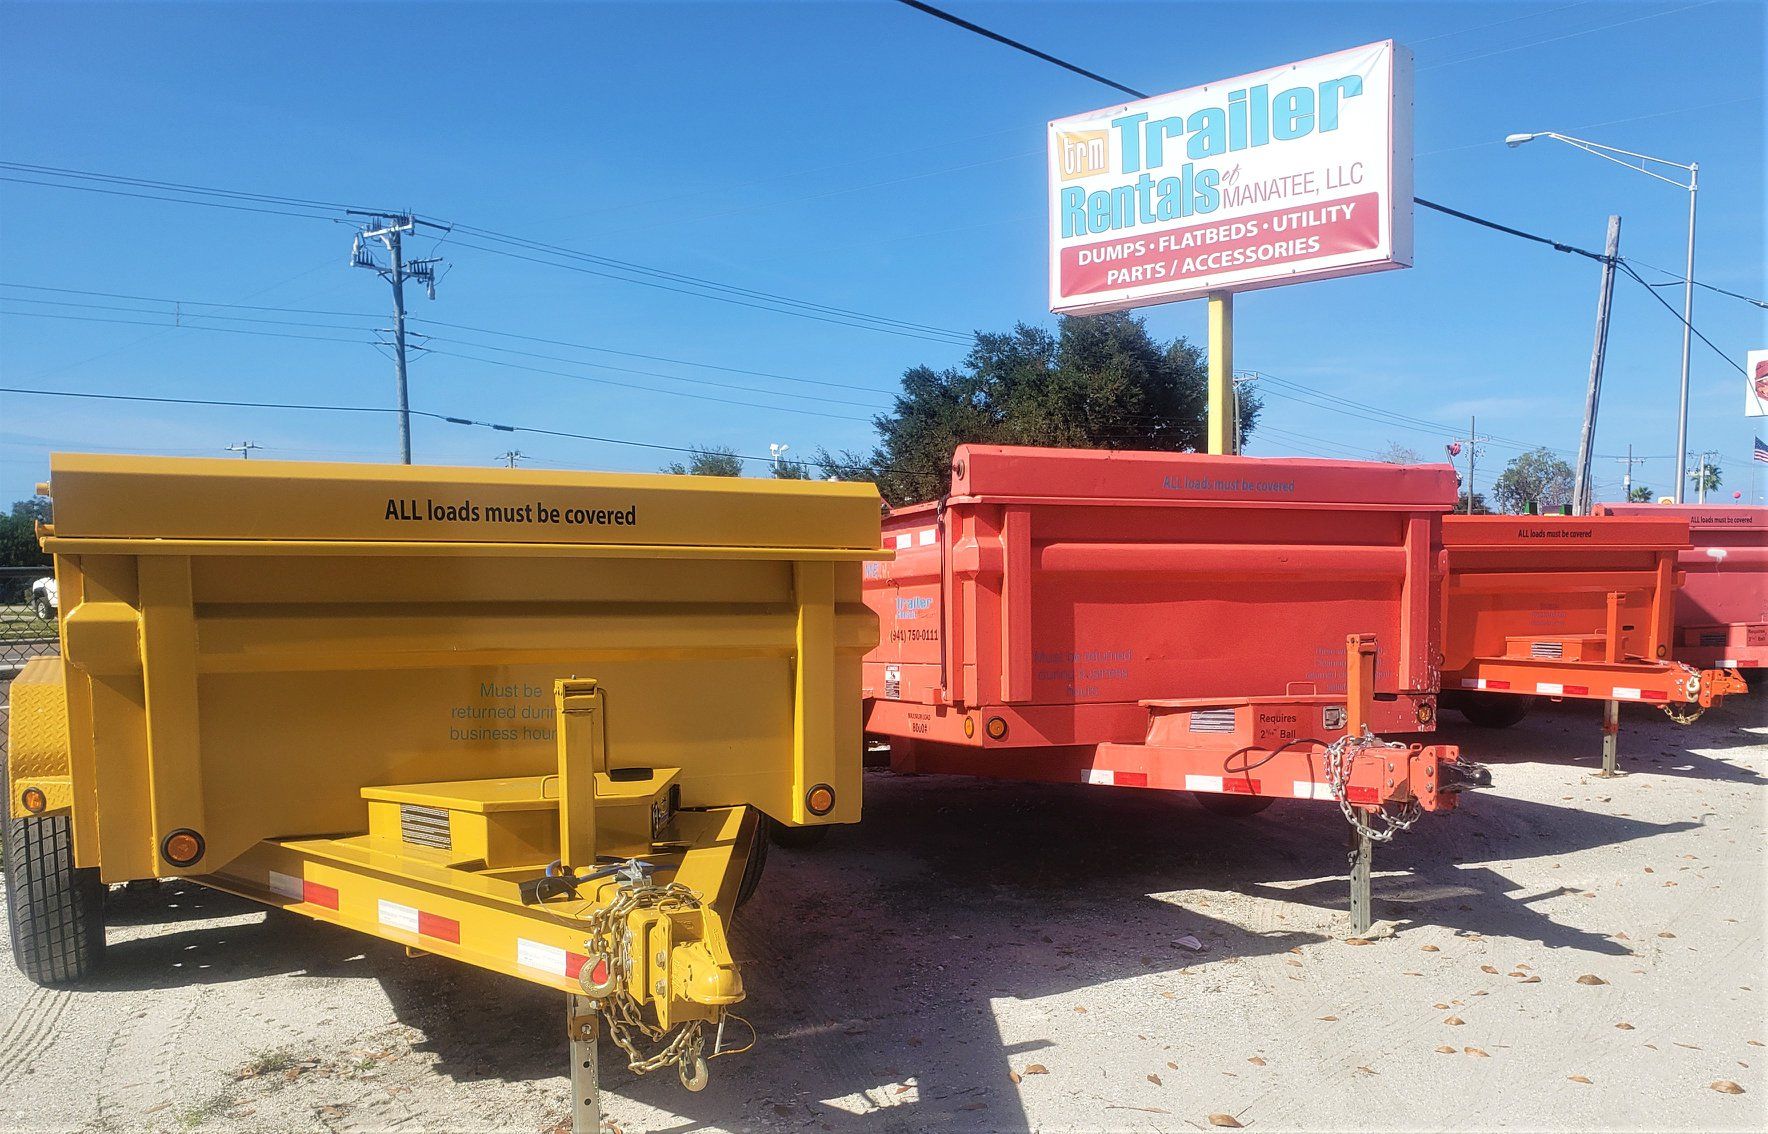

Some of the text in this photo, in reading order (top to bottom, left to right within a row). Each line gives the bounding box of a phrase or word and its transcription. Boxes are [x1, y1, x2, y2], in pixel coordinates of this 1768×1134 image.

[1111, 74, 1363, 175] Trailer
[1063, 134, 1105, 175] trm
[1223, 161, 1364, 209] MANATEE, LLC
[1061, 162, 1220, 239] Rentals
[1078, 202, 1356, 266] DUMPS FLATBEDS UTILITY
[1107, 261, 1166, 286] PARTS
[1181, 235, 1320, 274] ACCESSORIES
[1214, 480, 1238, 491] must
[1241, 479, 1253, 491] be
[1256, 480, 1294, 492] covered
[385, 499, 636, 526] ALL loads must be covered
[1518, 530, 1529, 538] ALL
[1530, 530, 1545, 538] loads
[1562, 530, 1569, 538] be
[1570, 530, 1592, 538] covered
[480, 682, 543, 698] Must be
[451, 705, 516, 719] returned
[1259, 714, 1297, 724] Requires
[450, 726, 557, 740] business hour
[1280, 729, 1296, 739] Ball
